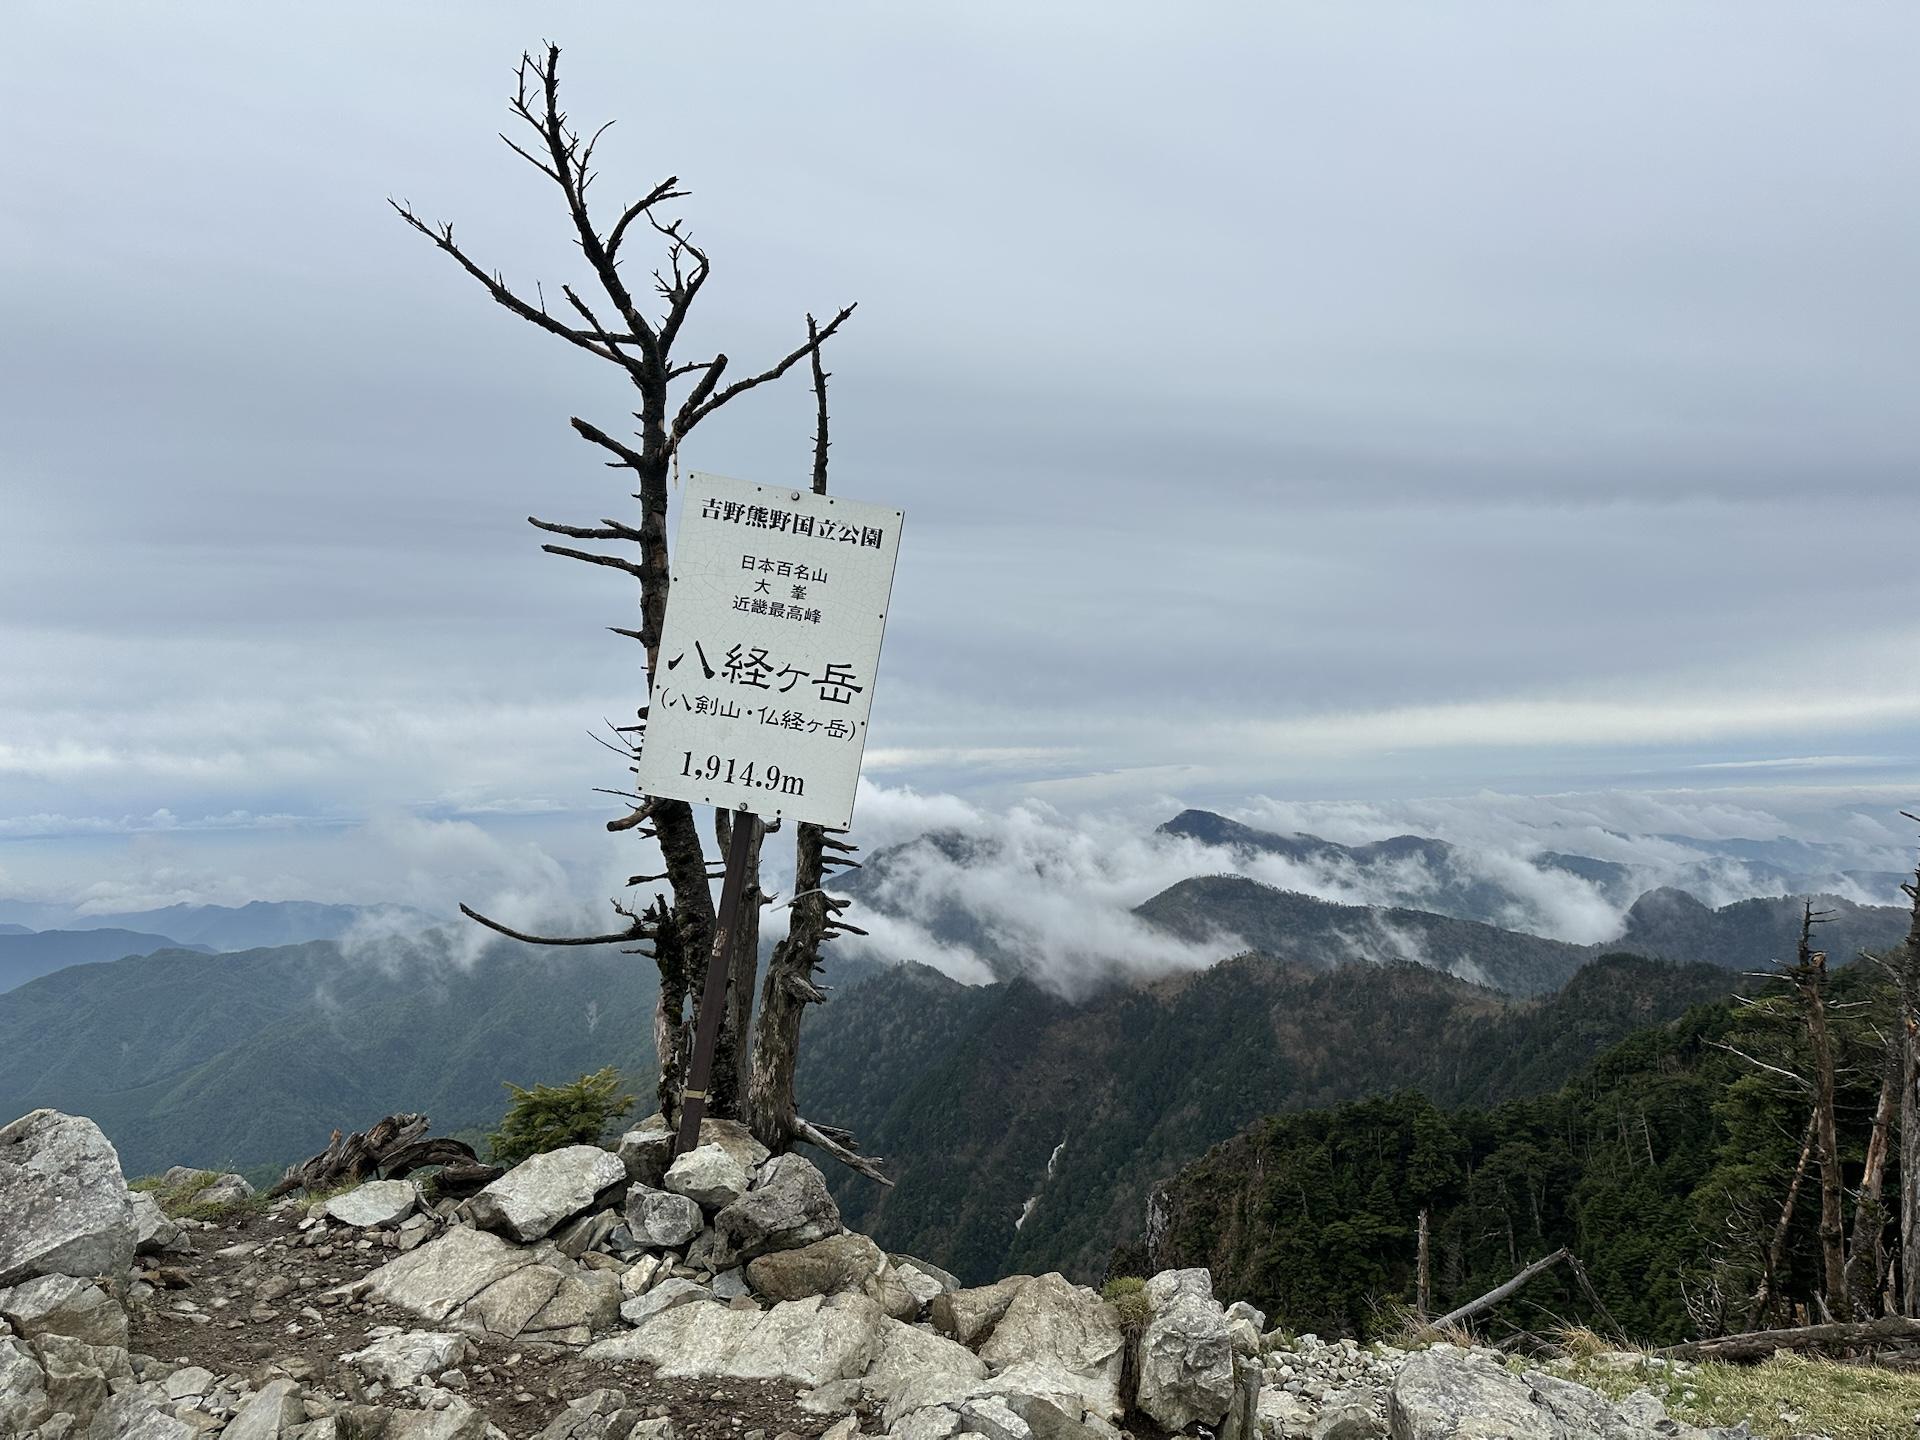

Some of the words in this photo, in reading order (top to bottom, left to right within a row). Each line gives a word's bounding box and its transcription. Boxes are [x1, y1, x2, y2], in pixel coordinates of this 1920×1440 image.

[741, 554, 828, 584] 日本百名山
[732, 595, 822, 625] 近畿最高峰
[680, 751, 804, 796] 1,914.9m
